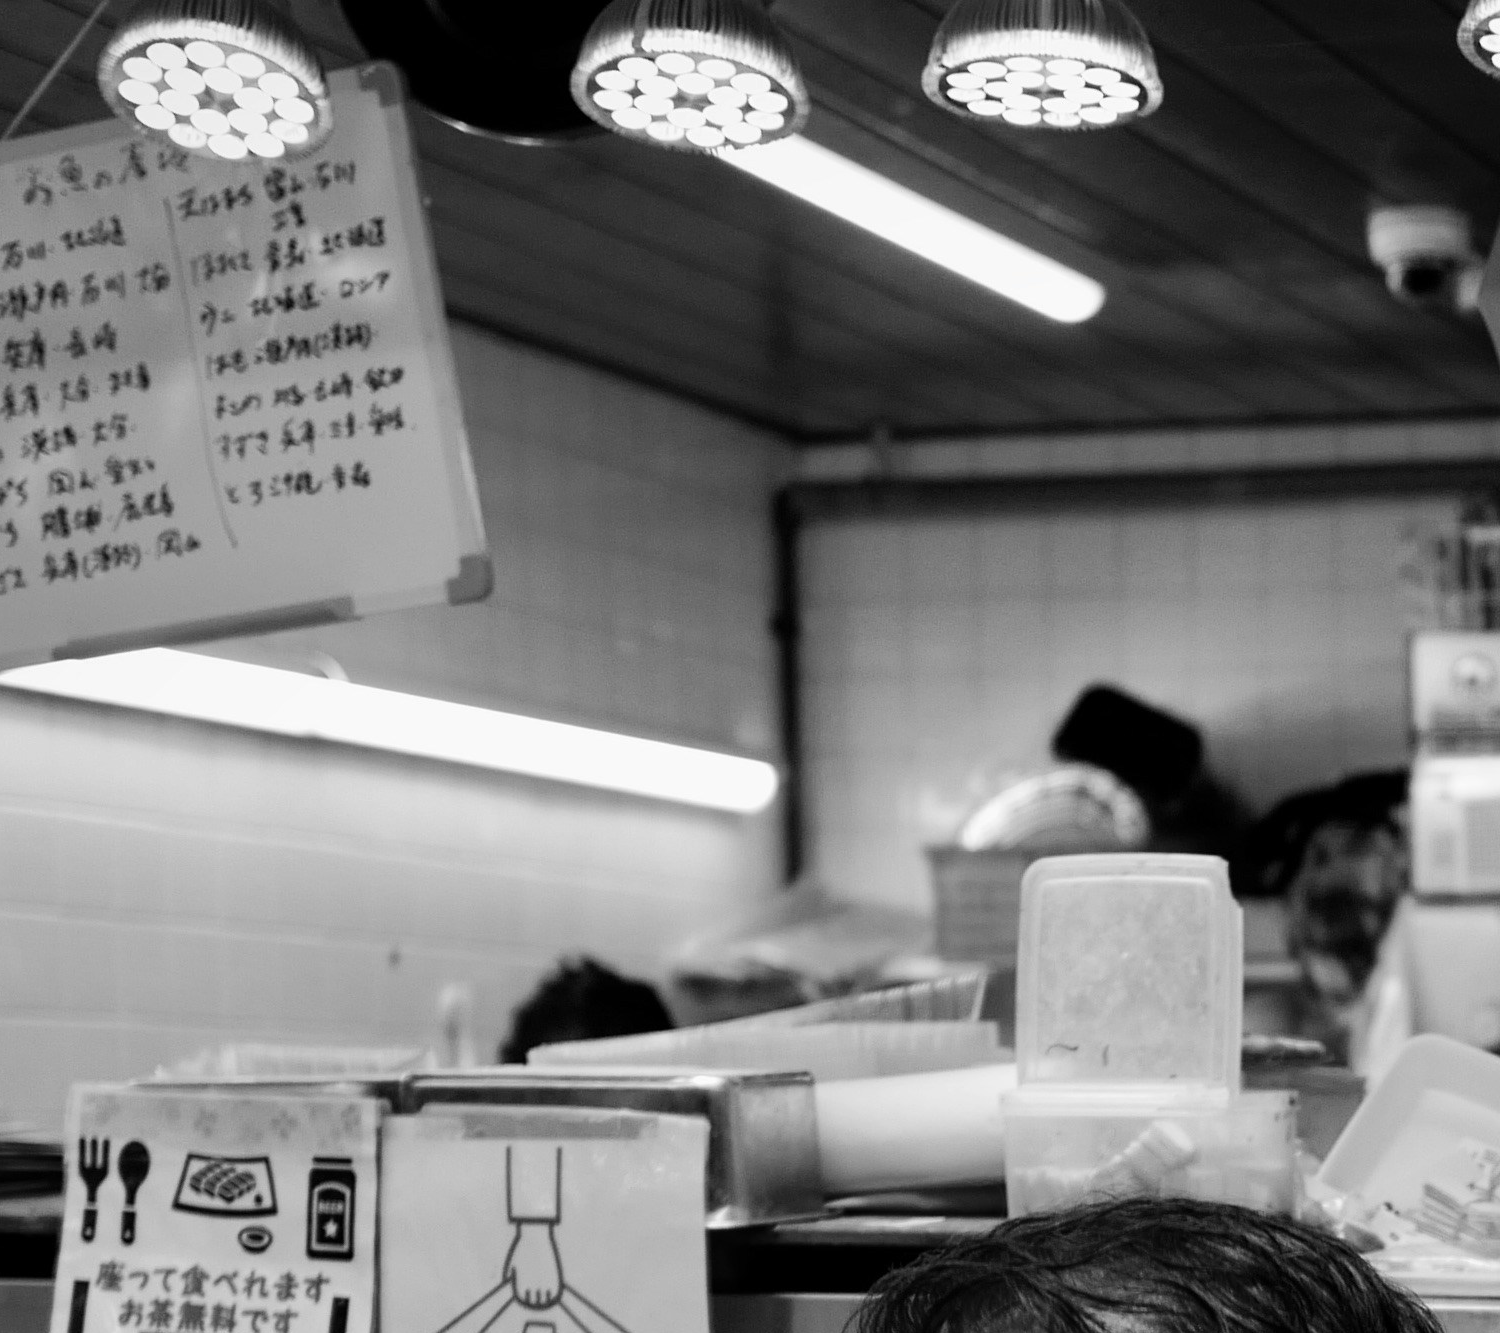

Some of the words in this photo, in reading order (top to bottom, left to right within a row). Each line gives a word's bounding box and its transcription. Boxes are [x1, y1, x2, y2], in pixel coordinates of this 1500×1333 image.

[95, 1260, 330, 1302] 座って食べれます
